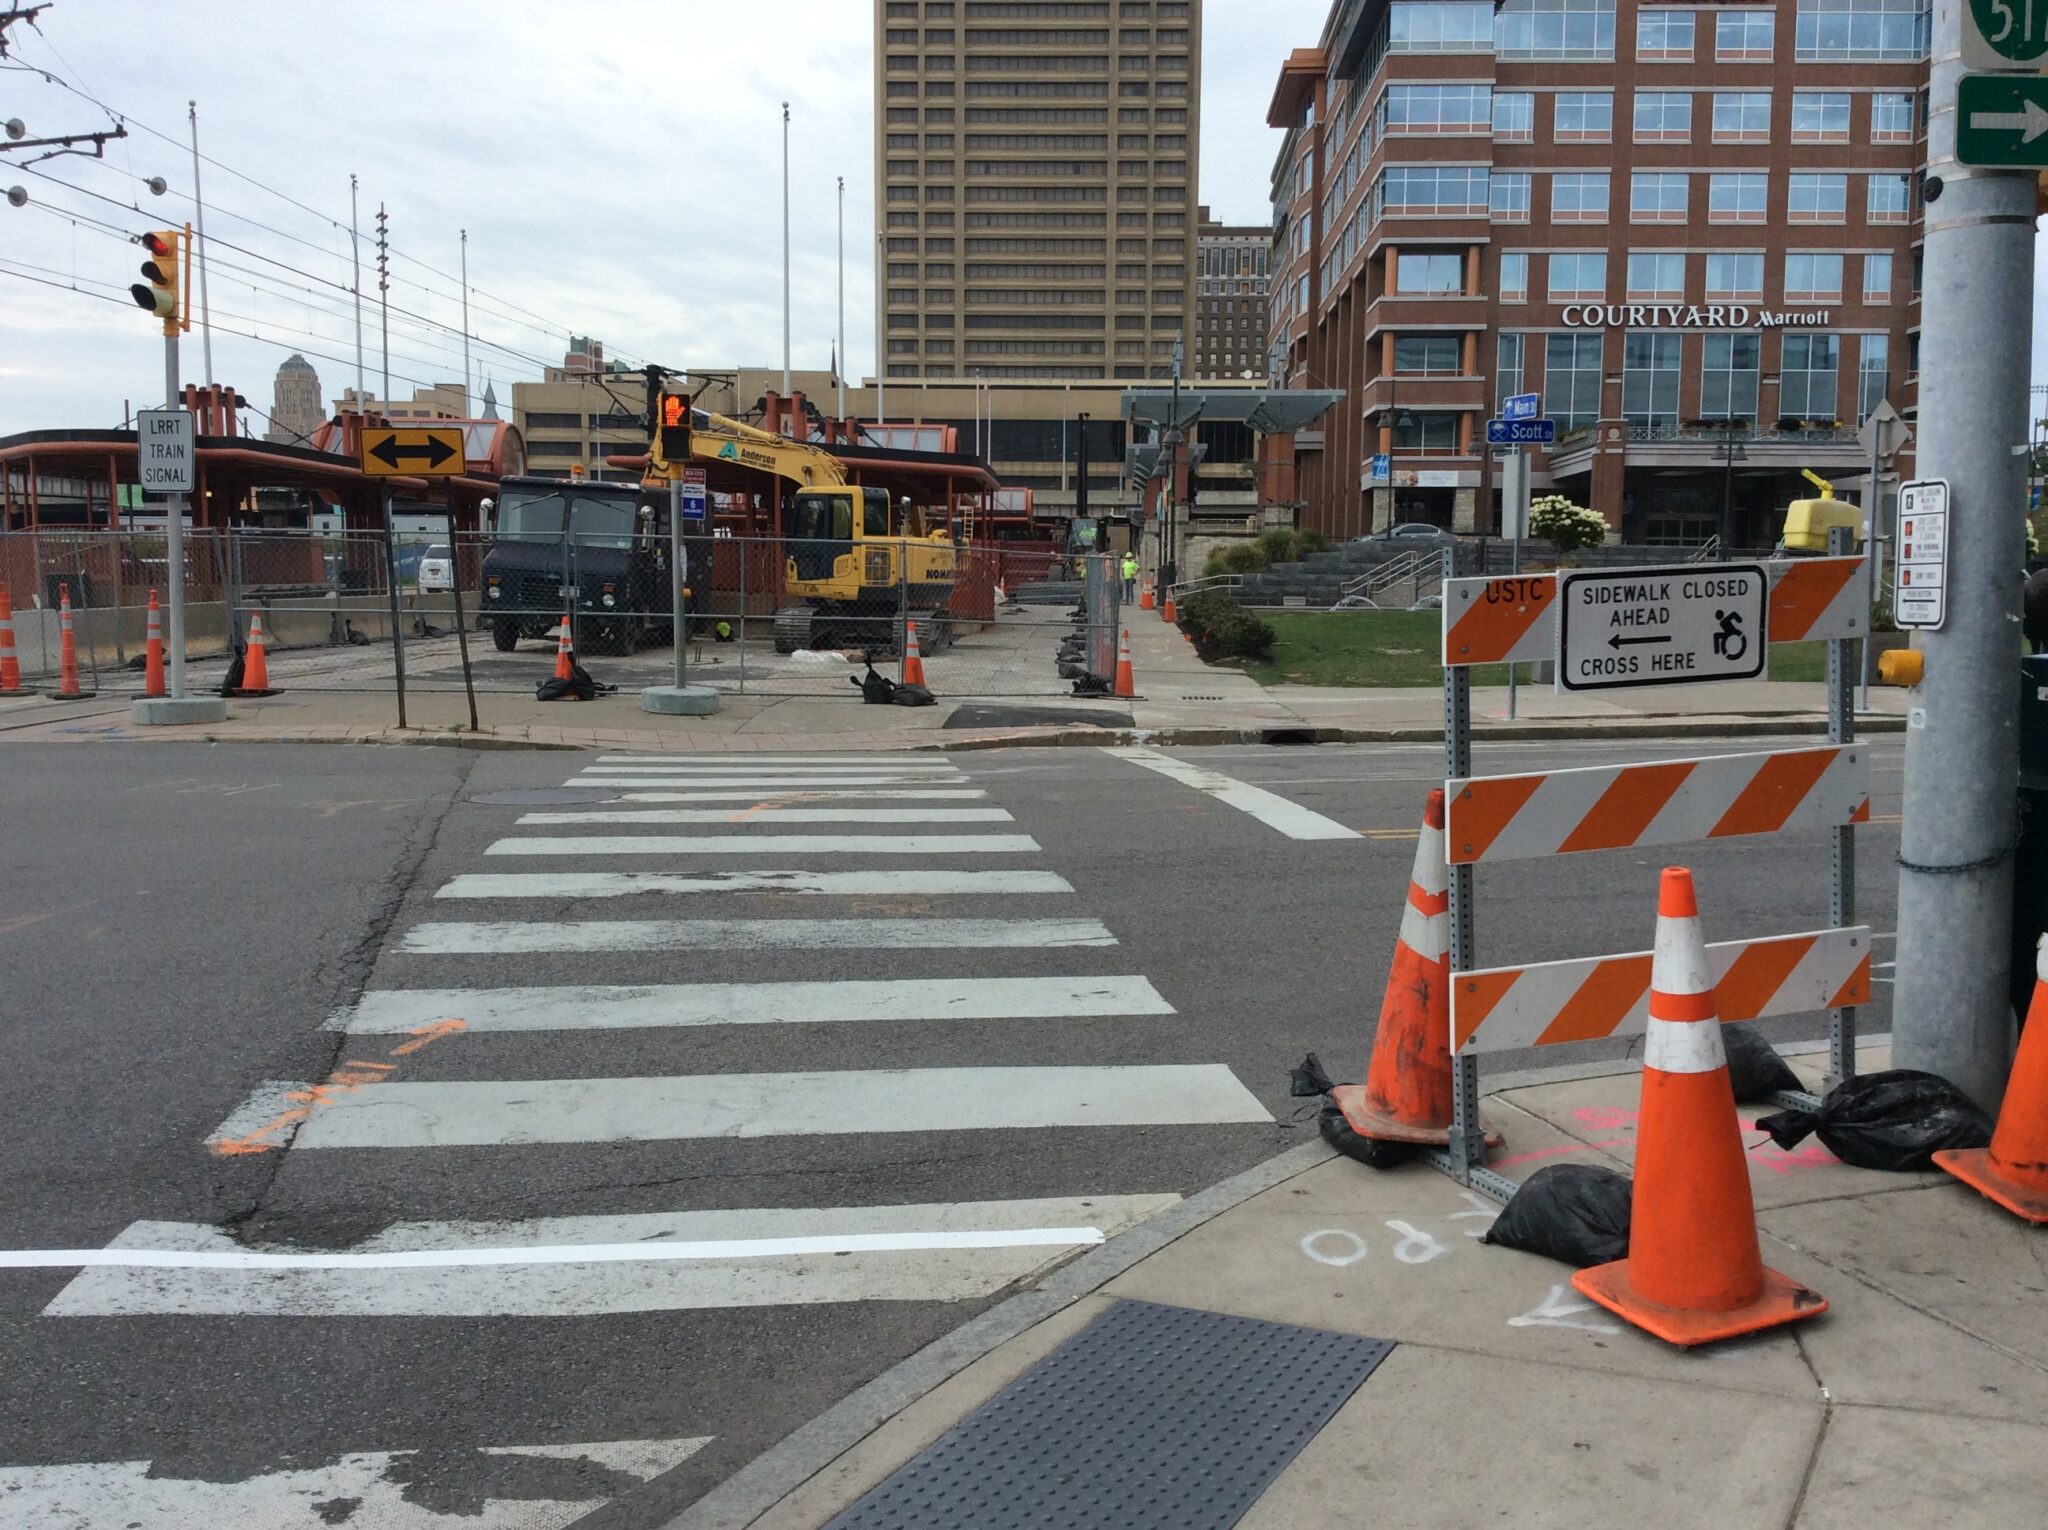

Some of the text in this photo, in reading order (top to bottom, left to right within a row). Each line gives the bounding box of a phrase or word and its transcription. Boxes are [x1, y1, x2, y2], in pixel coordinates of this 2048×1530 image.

[1990, 0, 2048, 42] 51
[1561, 304, 1830, 328] COURTYARD Marriott
[150, 419, 181, 435] LRRT
[1510, 423, 1543, 440] Scott
[149, 443, 185, 459] TRAIN
[740, 447, 776, 465] Anderson
[145, 467, 187, 483] SIGNAL
[1485, 578, 1543, 604] USTC
[1582, 579, 1749, 605] SIDEWALK CLOSED
[1609, 607, 1671, 628] AHEAD
[1580, 651, 1696, 677] CROSS HERE
